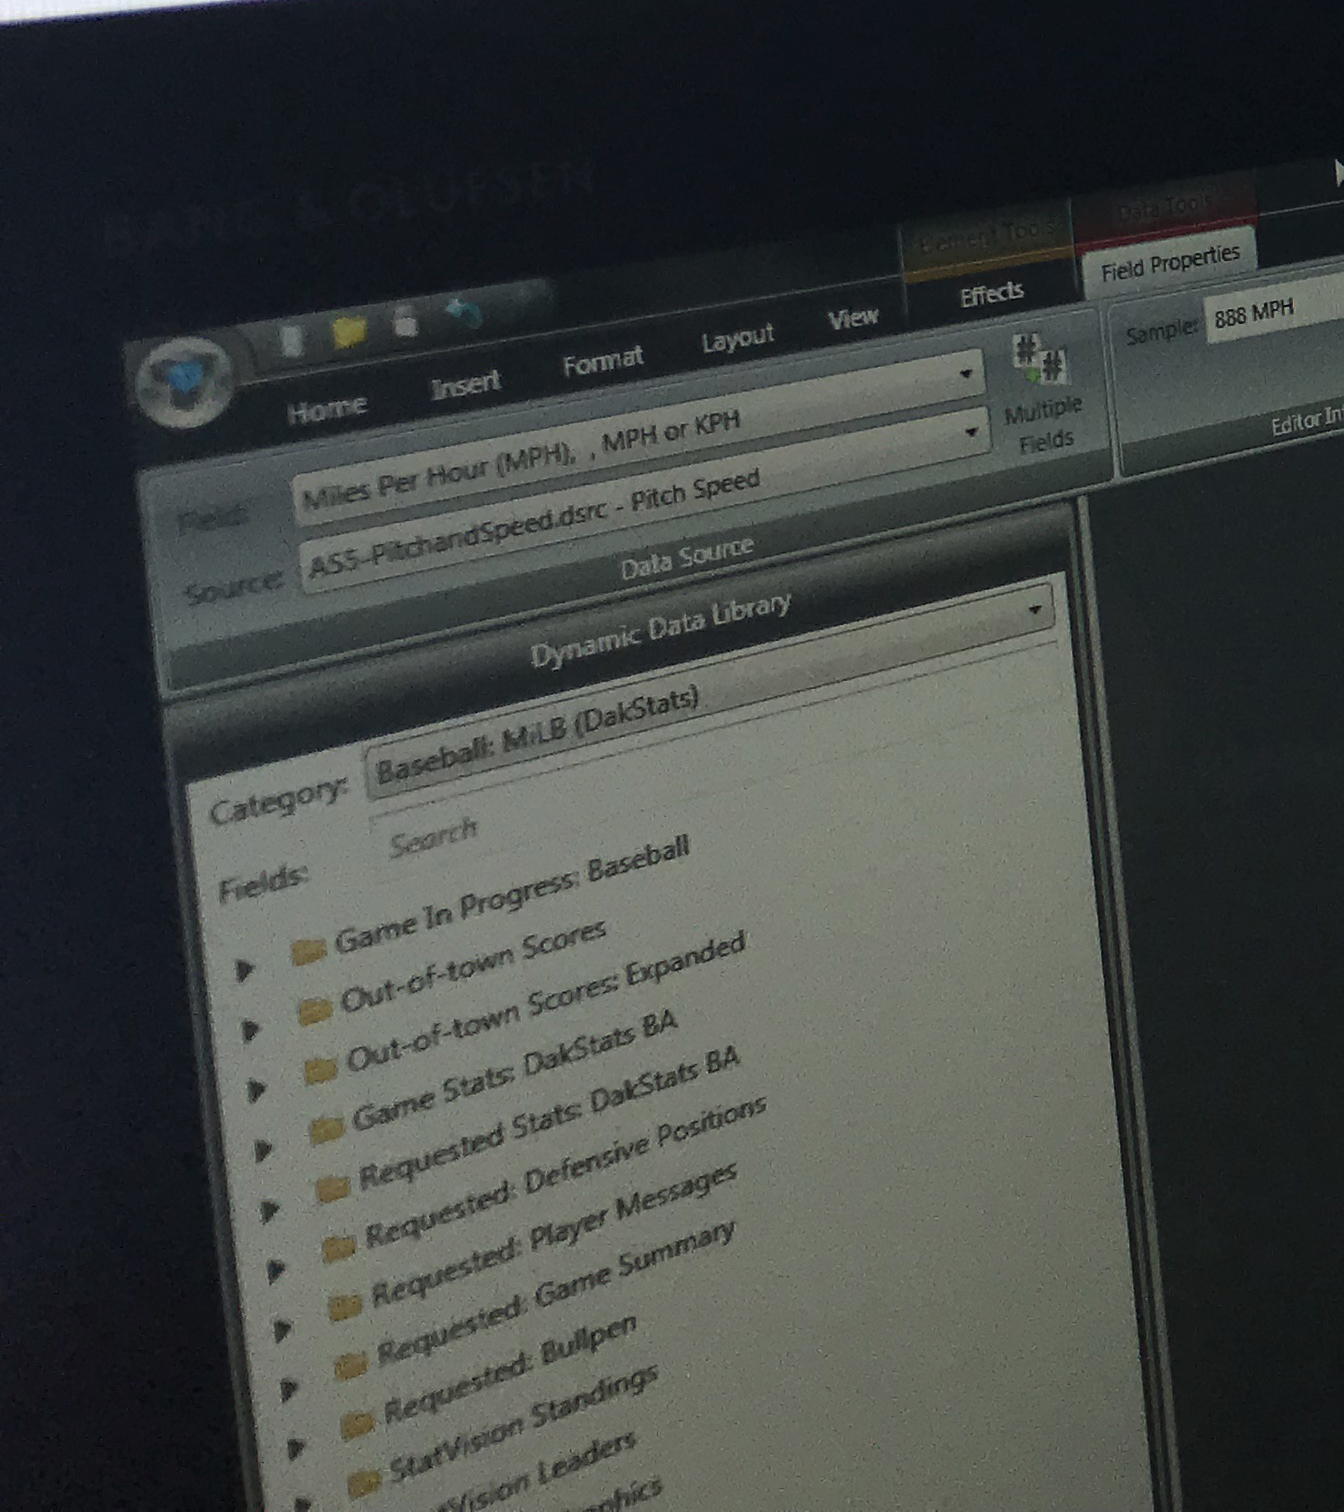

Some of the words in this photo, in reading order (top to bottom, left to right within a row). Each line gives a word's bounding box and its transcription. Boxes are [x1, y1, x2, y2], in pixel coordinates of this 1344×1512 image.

[1102, 258, 1144, 284] Field
[1150, 243, 1241, 276] Properties
[287, 392, 368, 426] Home
[431, 368, 501, 402] Insert
[562, 345, 645, 379] Format
[701, 323, 775, 354] Layout
[827, 305, 880, 332] View
[960, 280, 1025, 310] Effects
[1126, 317, 1199, 347] Sample:
[1214, 304, 1247, 329] 888
[1251, 297, 1295, 322] MPH
[1004, 394, 1082, 426] Multiple
[1018, 429, 1074, 455] Fields
[1271, 411, 1322, 437] Editor
[302, 480, 370, 511] Miles
[377, 473, 417, 498] Per
[428, 459, 489, 489] Hour
[602, 424, 657, 454] MPH
[664, 422, 690, 441] or
[694, 409, 742, 435] KPH
[631, 482, 687, 514] Pitch
[693, 468, 761, 503] Speed
[186, 569, 286, 606] Source:
[621, 553, 672, 581] Data
[678, 536, 755, 570] Source
[530, 623, 642, 670] Dynamic
[648, 610, 706, 641] Data
[711, 592, 793, 631] Library
[209, 774, 348, 826] Category:
[376, 737, 495, 785] Baseball:
[502, 718, 569, 752] MiLB
[574, 684, 699, 741] (DakStats)
[218, 864, 309, 905] Fields:
[389, 817, 478, 860] Search
[334, 916, 418, 956] Game
[423, 905, 453, 930] In
[460, 870, 581, 921] Progress:
[587, 834, 692, 883] Baseball
[339, 945, 516, 1015] Out-of-town
[521, 919, 607, 960] Scores
[345, 1004, 521, 1075] Out-of-town
[527, 974, 620, 1018] Scores:
[624, 930, 747, 988] Expanded
[352, 1094, 435, 1134] Game
[442, 1064, 516, 1104] Stats:
[523, 1026, 637, 1078] DakStats
[642, 1009, 679, 1038] BA
[358, 1128, 505, 1194] Requested
[511, 1102, 583, 1140] Stats:
[590, 1064, 700, 1114] DakStats
[706, 1046, 742, 1074] BA
[365, 1185, 517, 1252] Requested:
[524, 1135, 652, 1195] Defensive
[657, 1094, 768, 1149] Positions
[371, 1239, 523, 1309] Requested:
[529, 1211, 609, 1253] Player
[616, 1163, 739, 1220] Messages
[376, 1297, 528, 1367] Requested:
[534, 1269, 612, 1308] Game
[617, 1219, 738, 1278] Summary
[382, 1356, 533, 1426] Requested:
[540, 1314, 638, 1367] Bullpen
[390, 1418, 524, 1481] StatVision
[532, 1361, 660, 1428] Standings
[538, 1432, 636, 1485] Leaders
